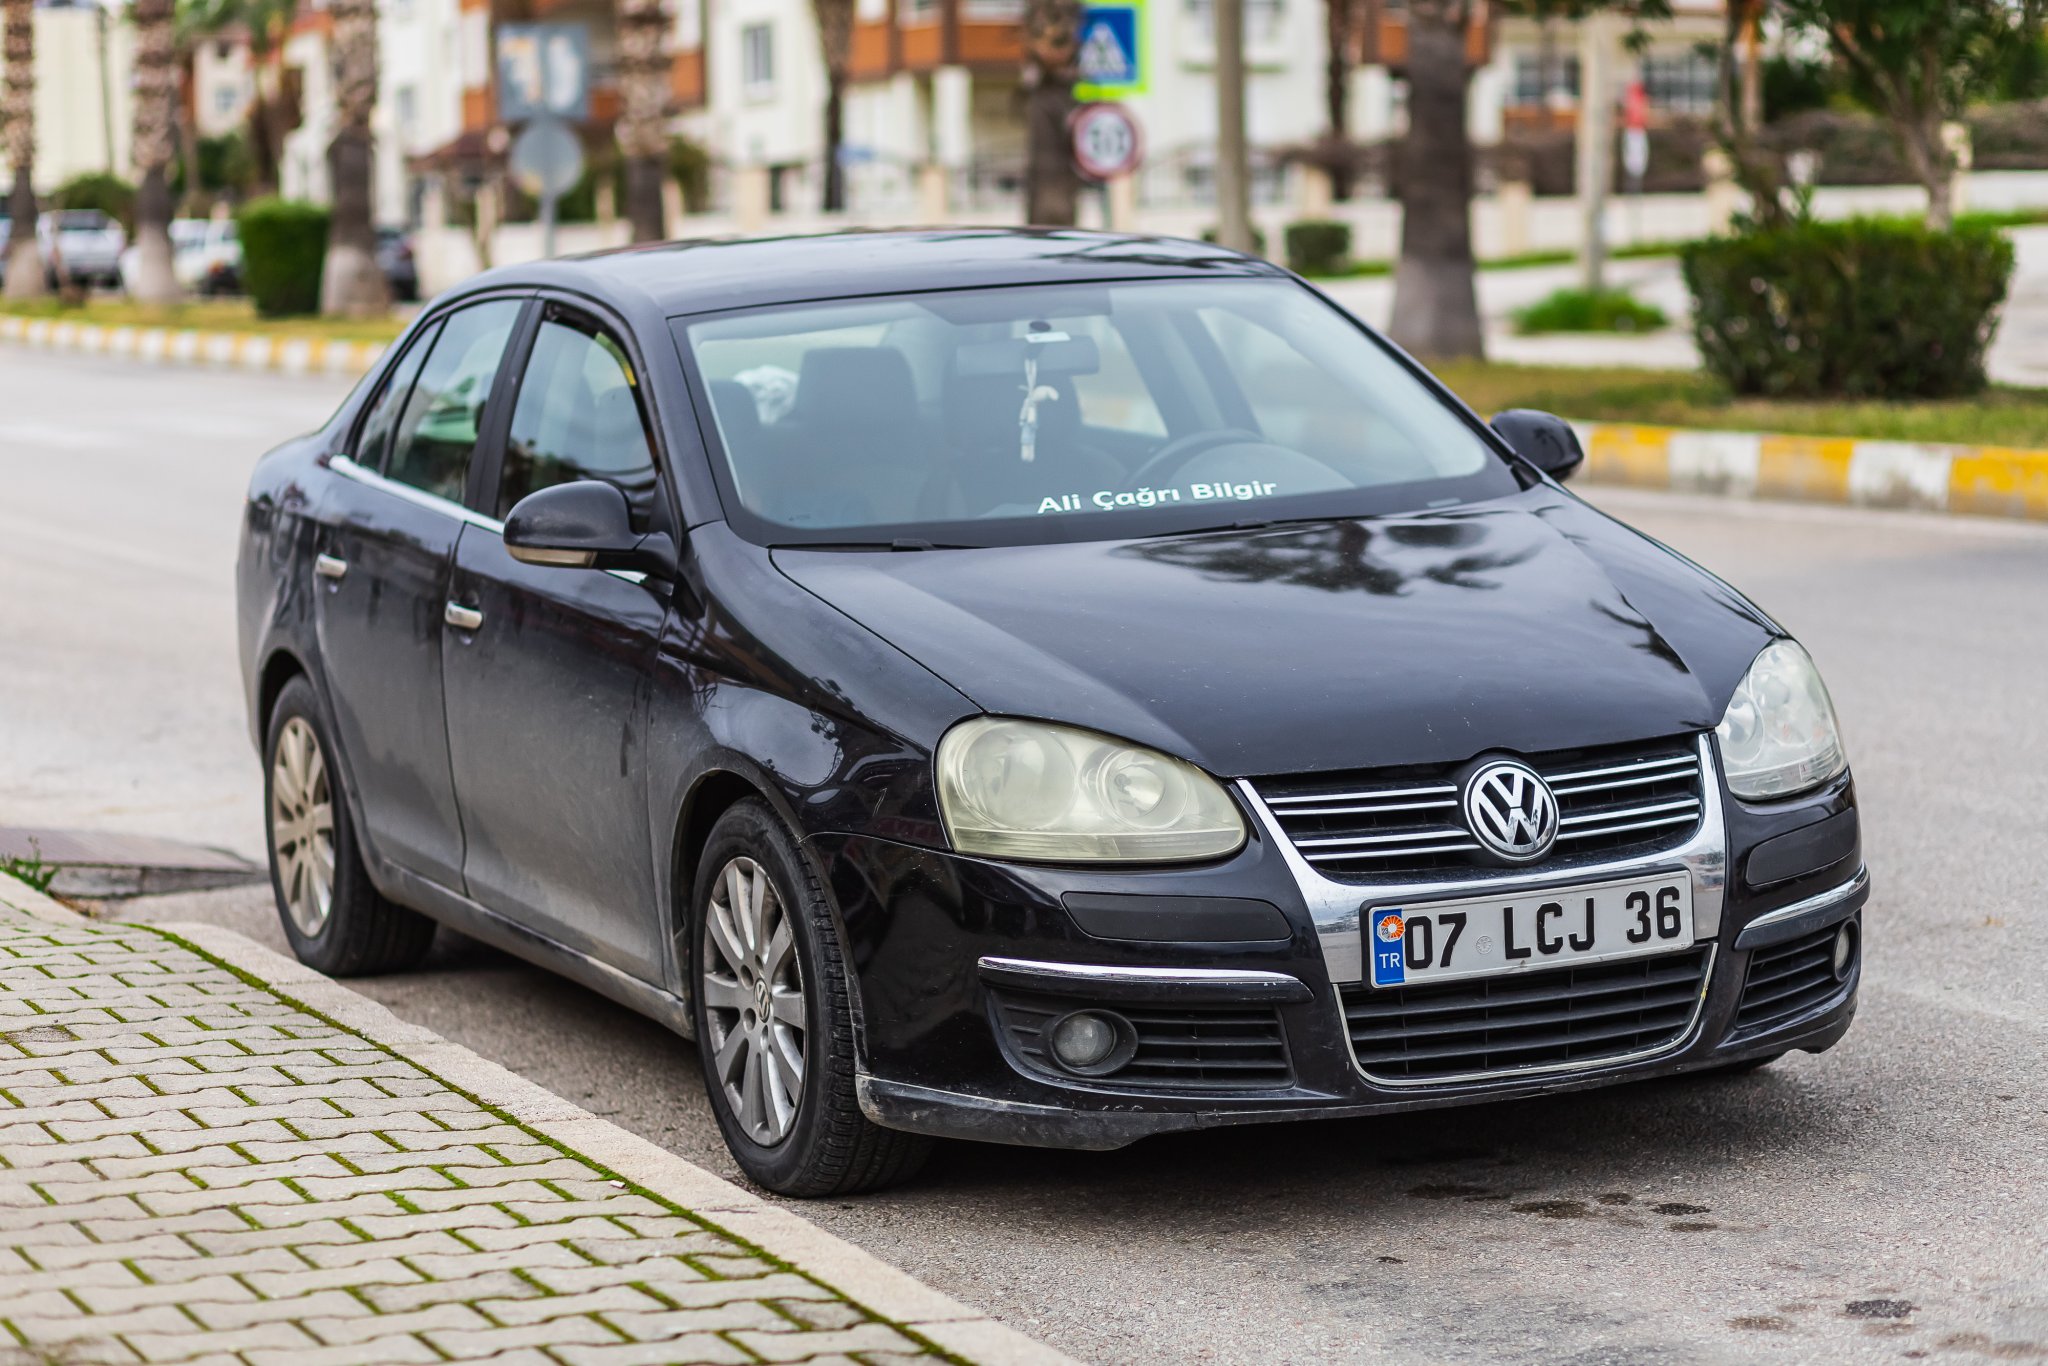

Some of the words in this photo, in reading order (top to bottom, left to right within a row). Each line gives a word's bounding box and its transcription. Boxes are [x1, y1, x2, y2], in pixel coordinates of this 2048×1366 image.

[1037, 493, 1082, 514] Ali
[1092, 487, 1180, 511] Çağrı
[1190, 480, 1277, 501] Bilgir
[1405, 912, 1467, 970] 07
[1504, 898, 1595, 960] LCJ
[1625, 886, 1682, 944] 36
[1379, 952, 1400, 969] TR
